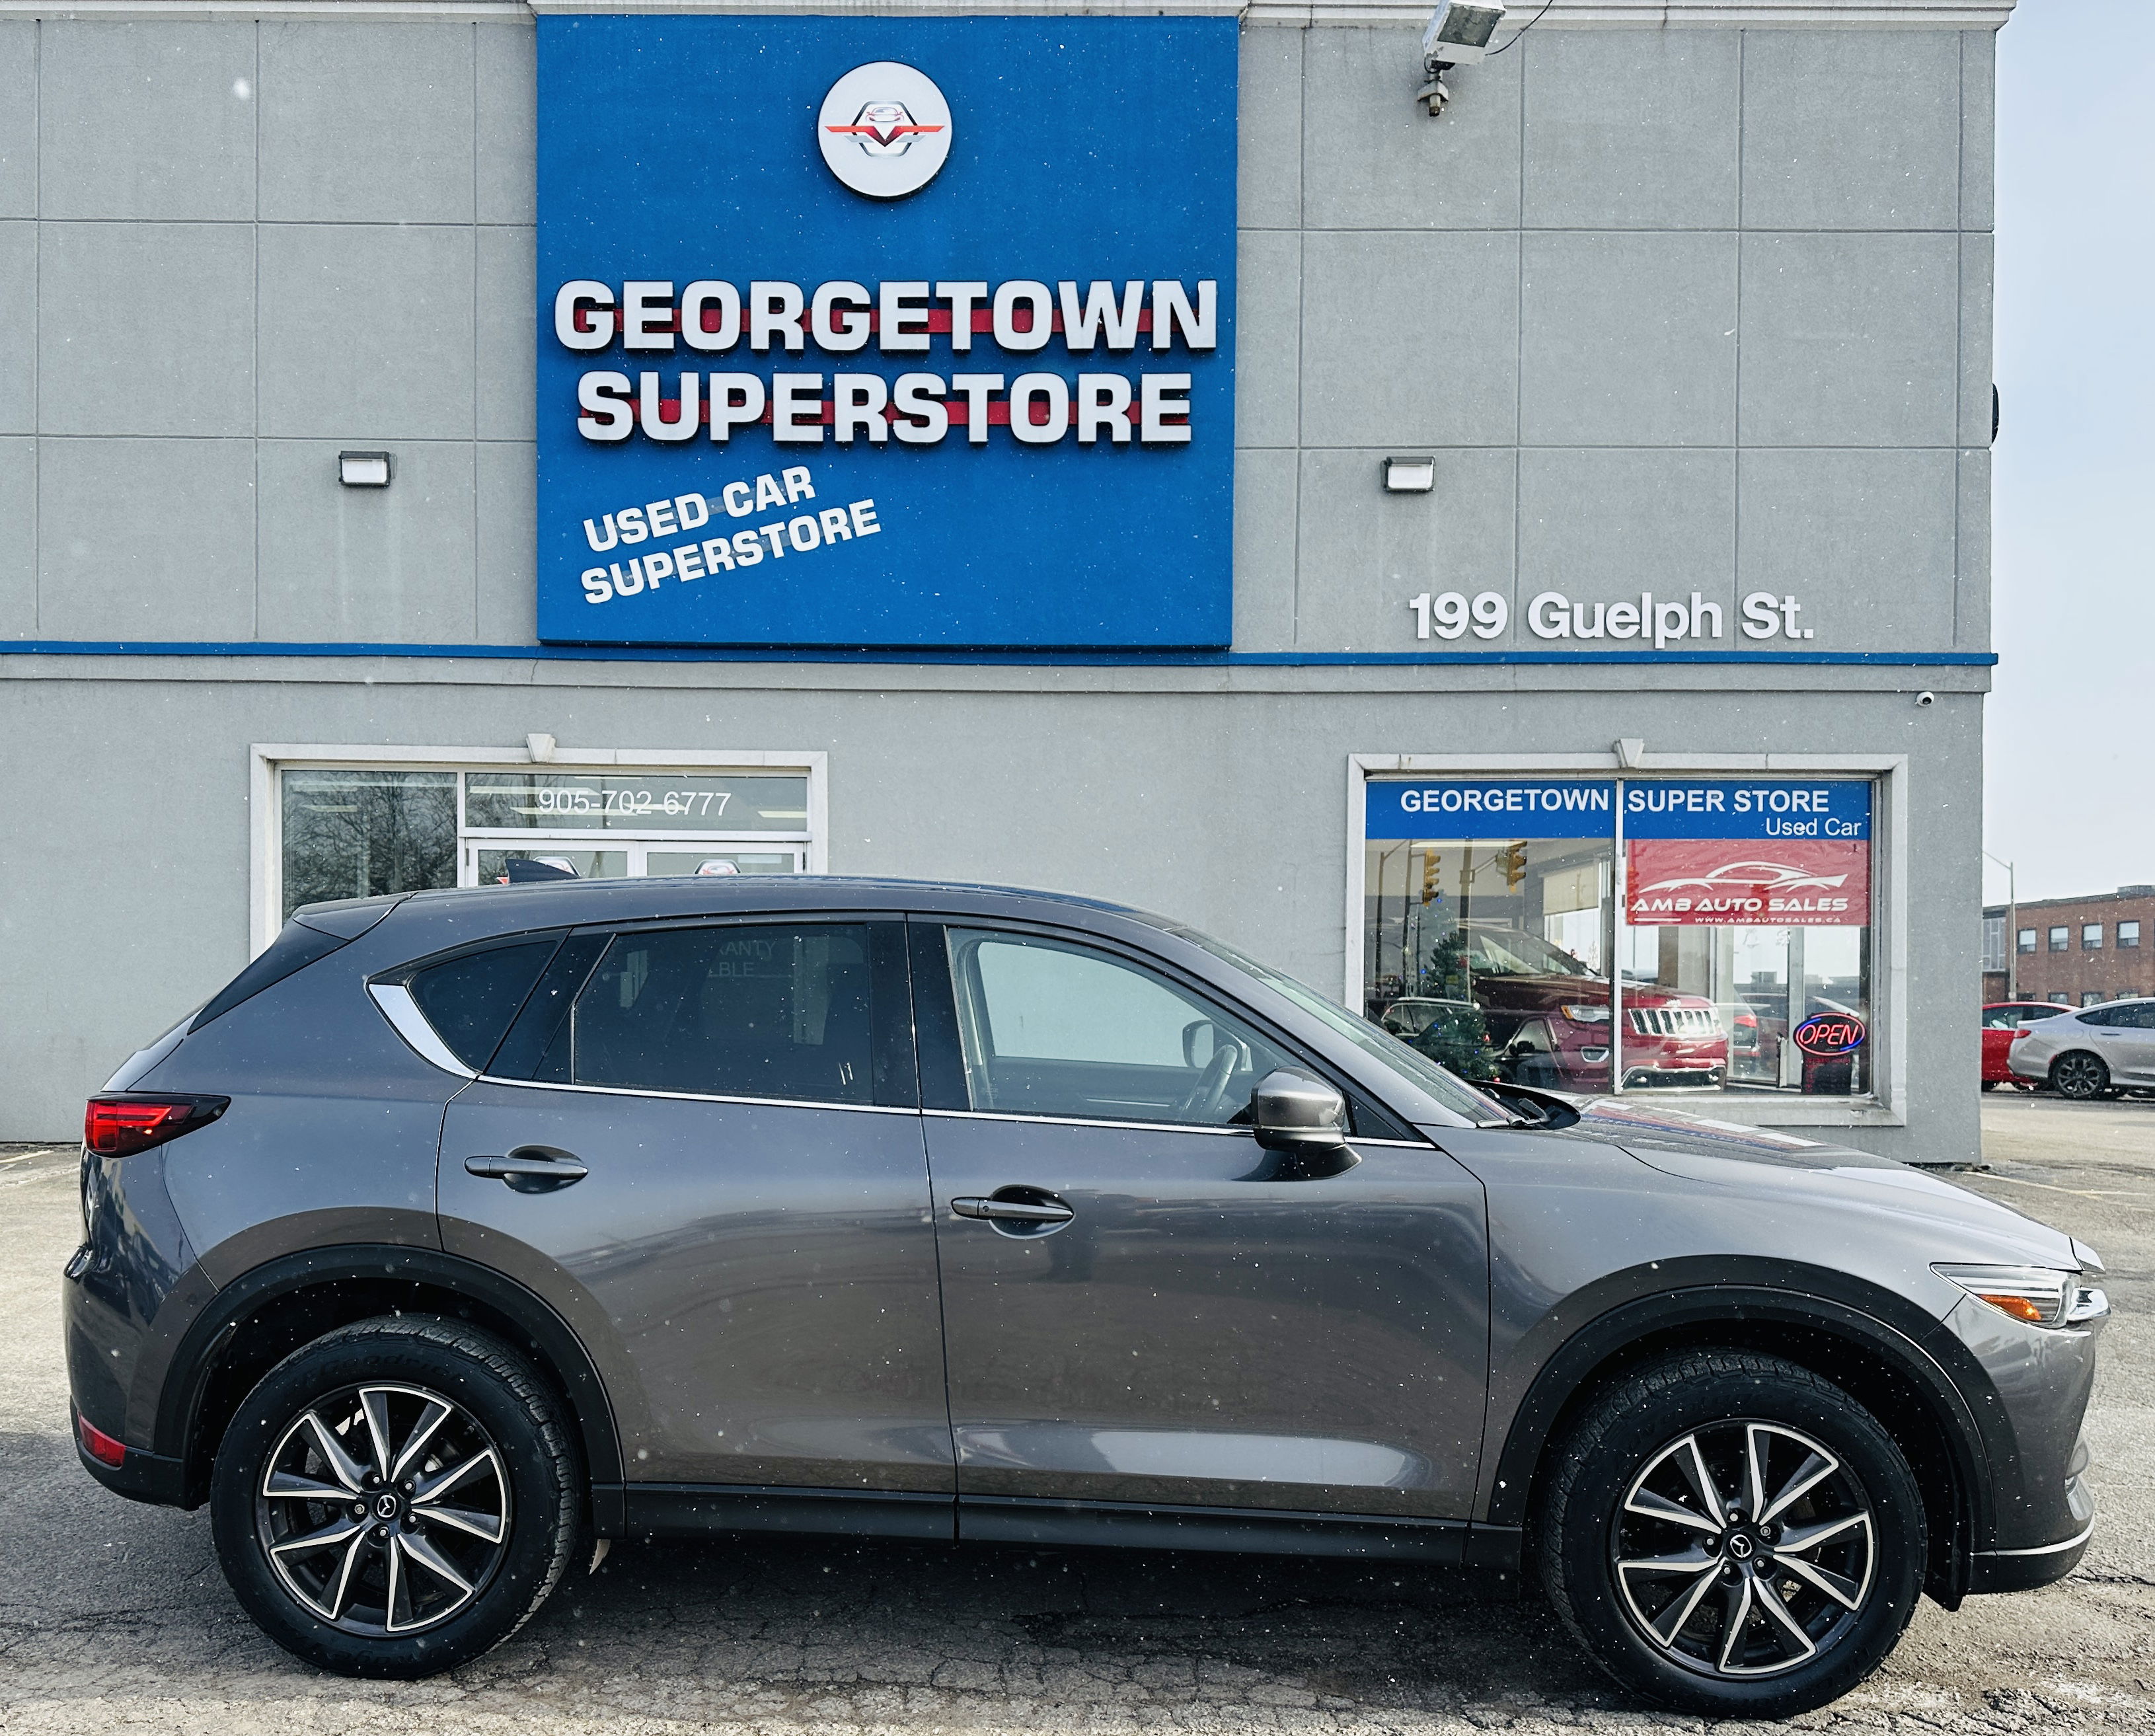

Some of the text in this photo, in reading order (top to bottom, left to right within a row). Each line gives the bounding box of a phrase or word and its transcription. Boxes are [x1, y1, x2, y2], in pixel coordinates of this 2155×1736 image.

[555, 280, 1217, 352] GEORGETOWN
[578, 371, 1192, 443] SUPERSTORE
[584, 466, 815, 552] USED CAR
[581, 499, 881, 603] SUPERSTORE
[1409, 591, 1814, 649] 199 Guelph St.
[539, 789, 732, 816] 905-702-6777
[1400, 788, 1829, 812] GEORGETOWN SUPER STORE
[1766, 817, 1862, 836] Used Car
[1630, 897, 1848, 912] AMB AUTO SALES
[710, 962, 755, 977] BLE
[1799, 1024, 1859, 1045] OPEN
